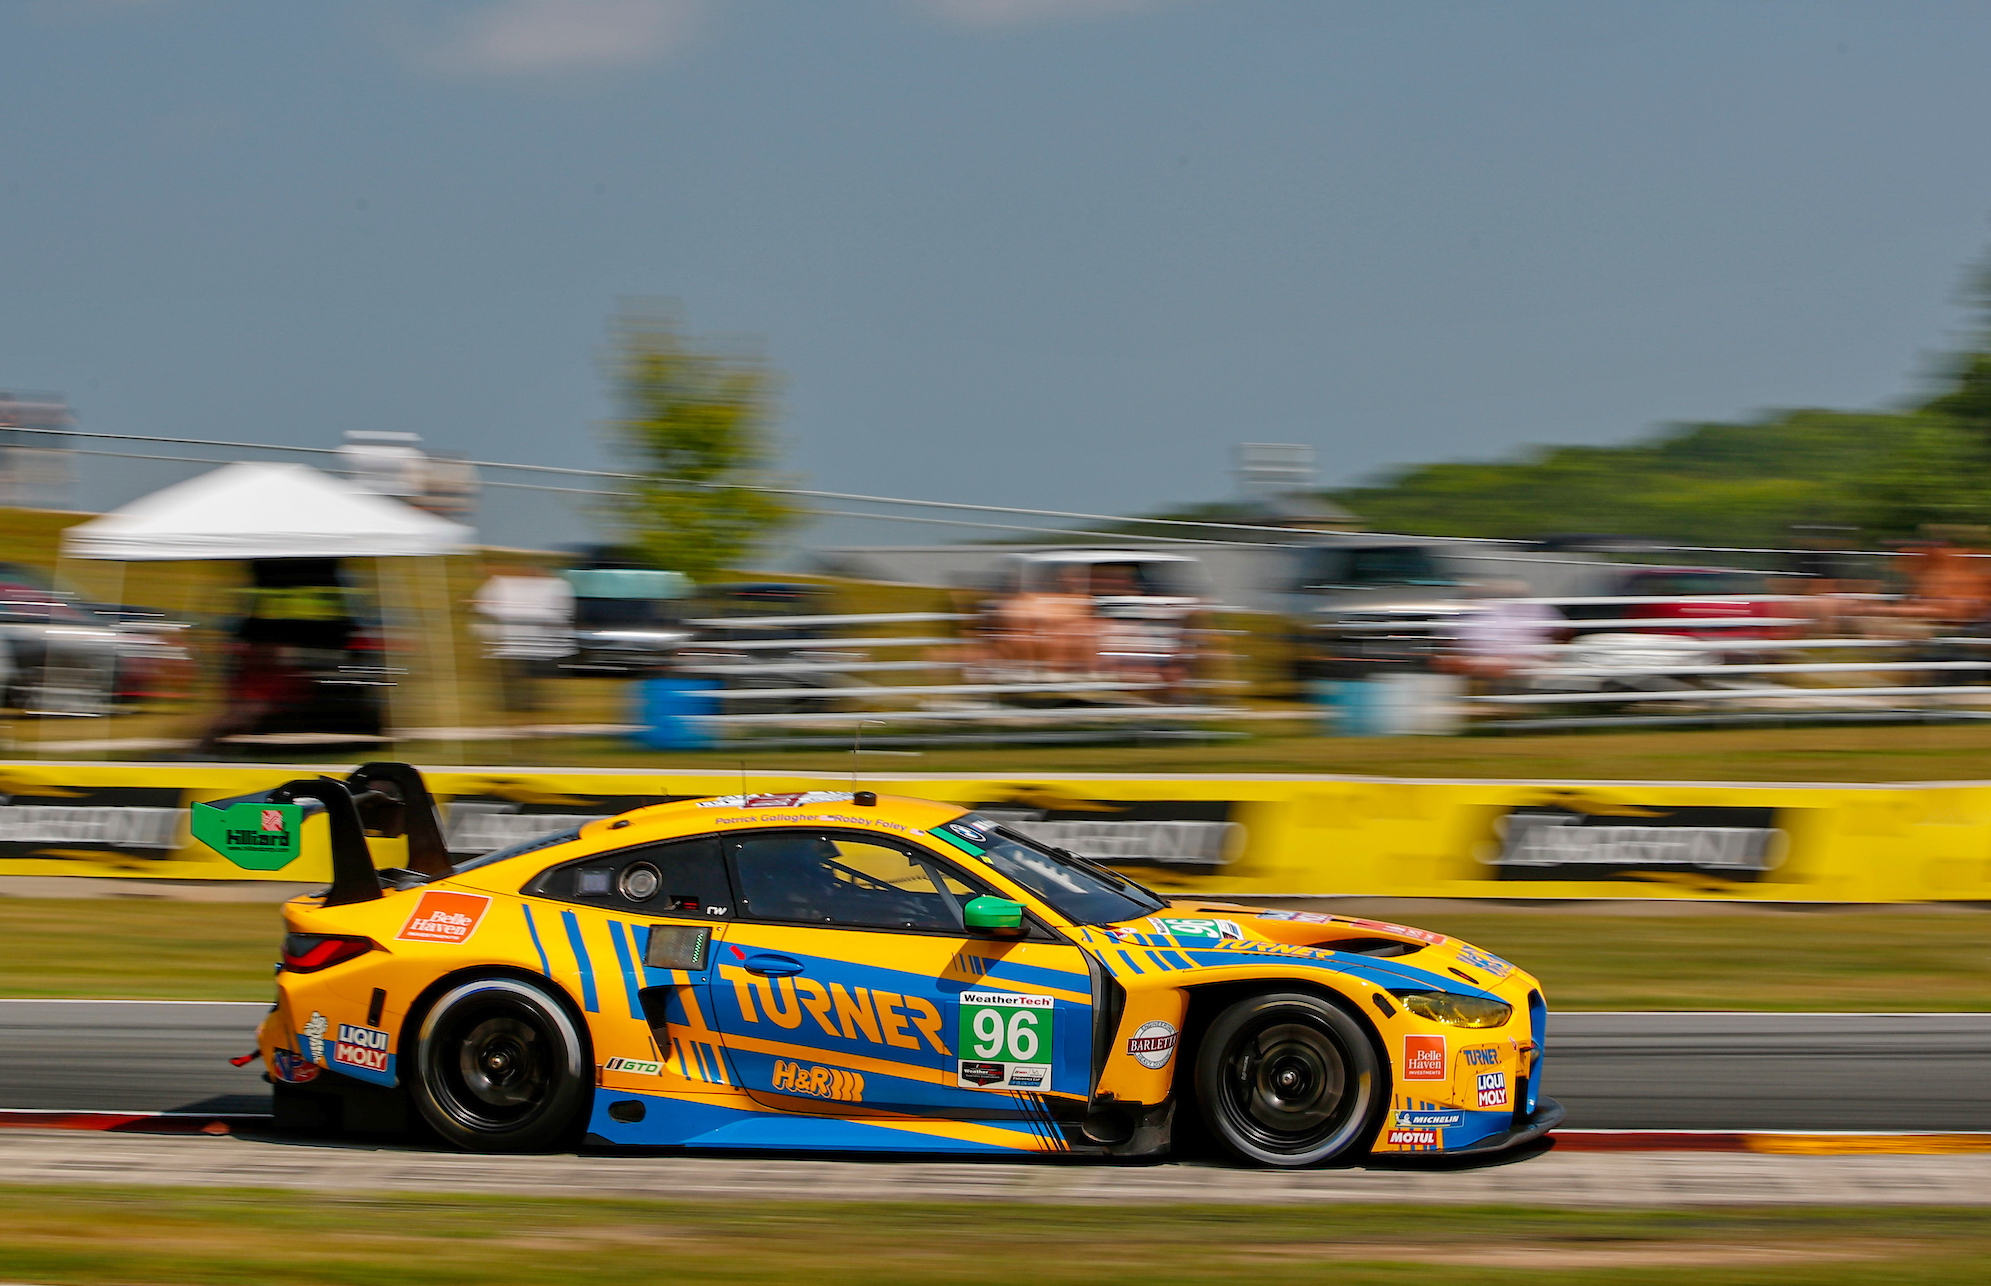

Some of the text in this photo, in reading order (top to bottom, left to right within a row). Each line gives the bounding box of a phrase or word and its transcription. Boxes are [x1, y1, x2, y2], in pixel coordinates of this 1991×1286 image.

[715, 814, 819, 825] Patrick Gallagher
[834, 814, 908, 832] Robby Foley
[409, 918, 467, 935] Haven
[430, 910, 473, 927] Belle
[1213, 938, 1336, 958] TURNER
[963, 993, 1051, 1006] WeatherTech
[718, 963, 953, 1057] TURNER
[340, 1025, 387, 1050] LIQUI
[973, 1008, 1039, 1061] 96
[338, 1043, 387, 1069] MOLY
[1417, 1050, 1441, 1060] Belle
[1463, 1049, 1498, 1066] TURNER
[622, 1061, 658, 1073] GTD
[1408, 1059, 1442, 1069] Haven
[772, 1060, 833, 1098] H&R
[1478, 1073, 1504, 1090] LIQUI
[1478, 1089, 1506, 1107] MOLY
[1413, 1115, 1459, 1123] MICHELIN
[1390, 1132, 1435, 1143] MOTUL
